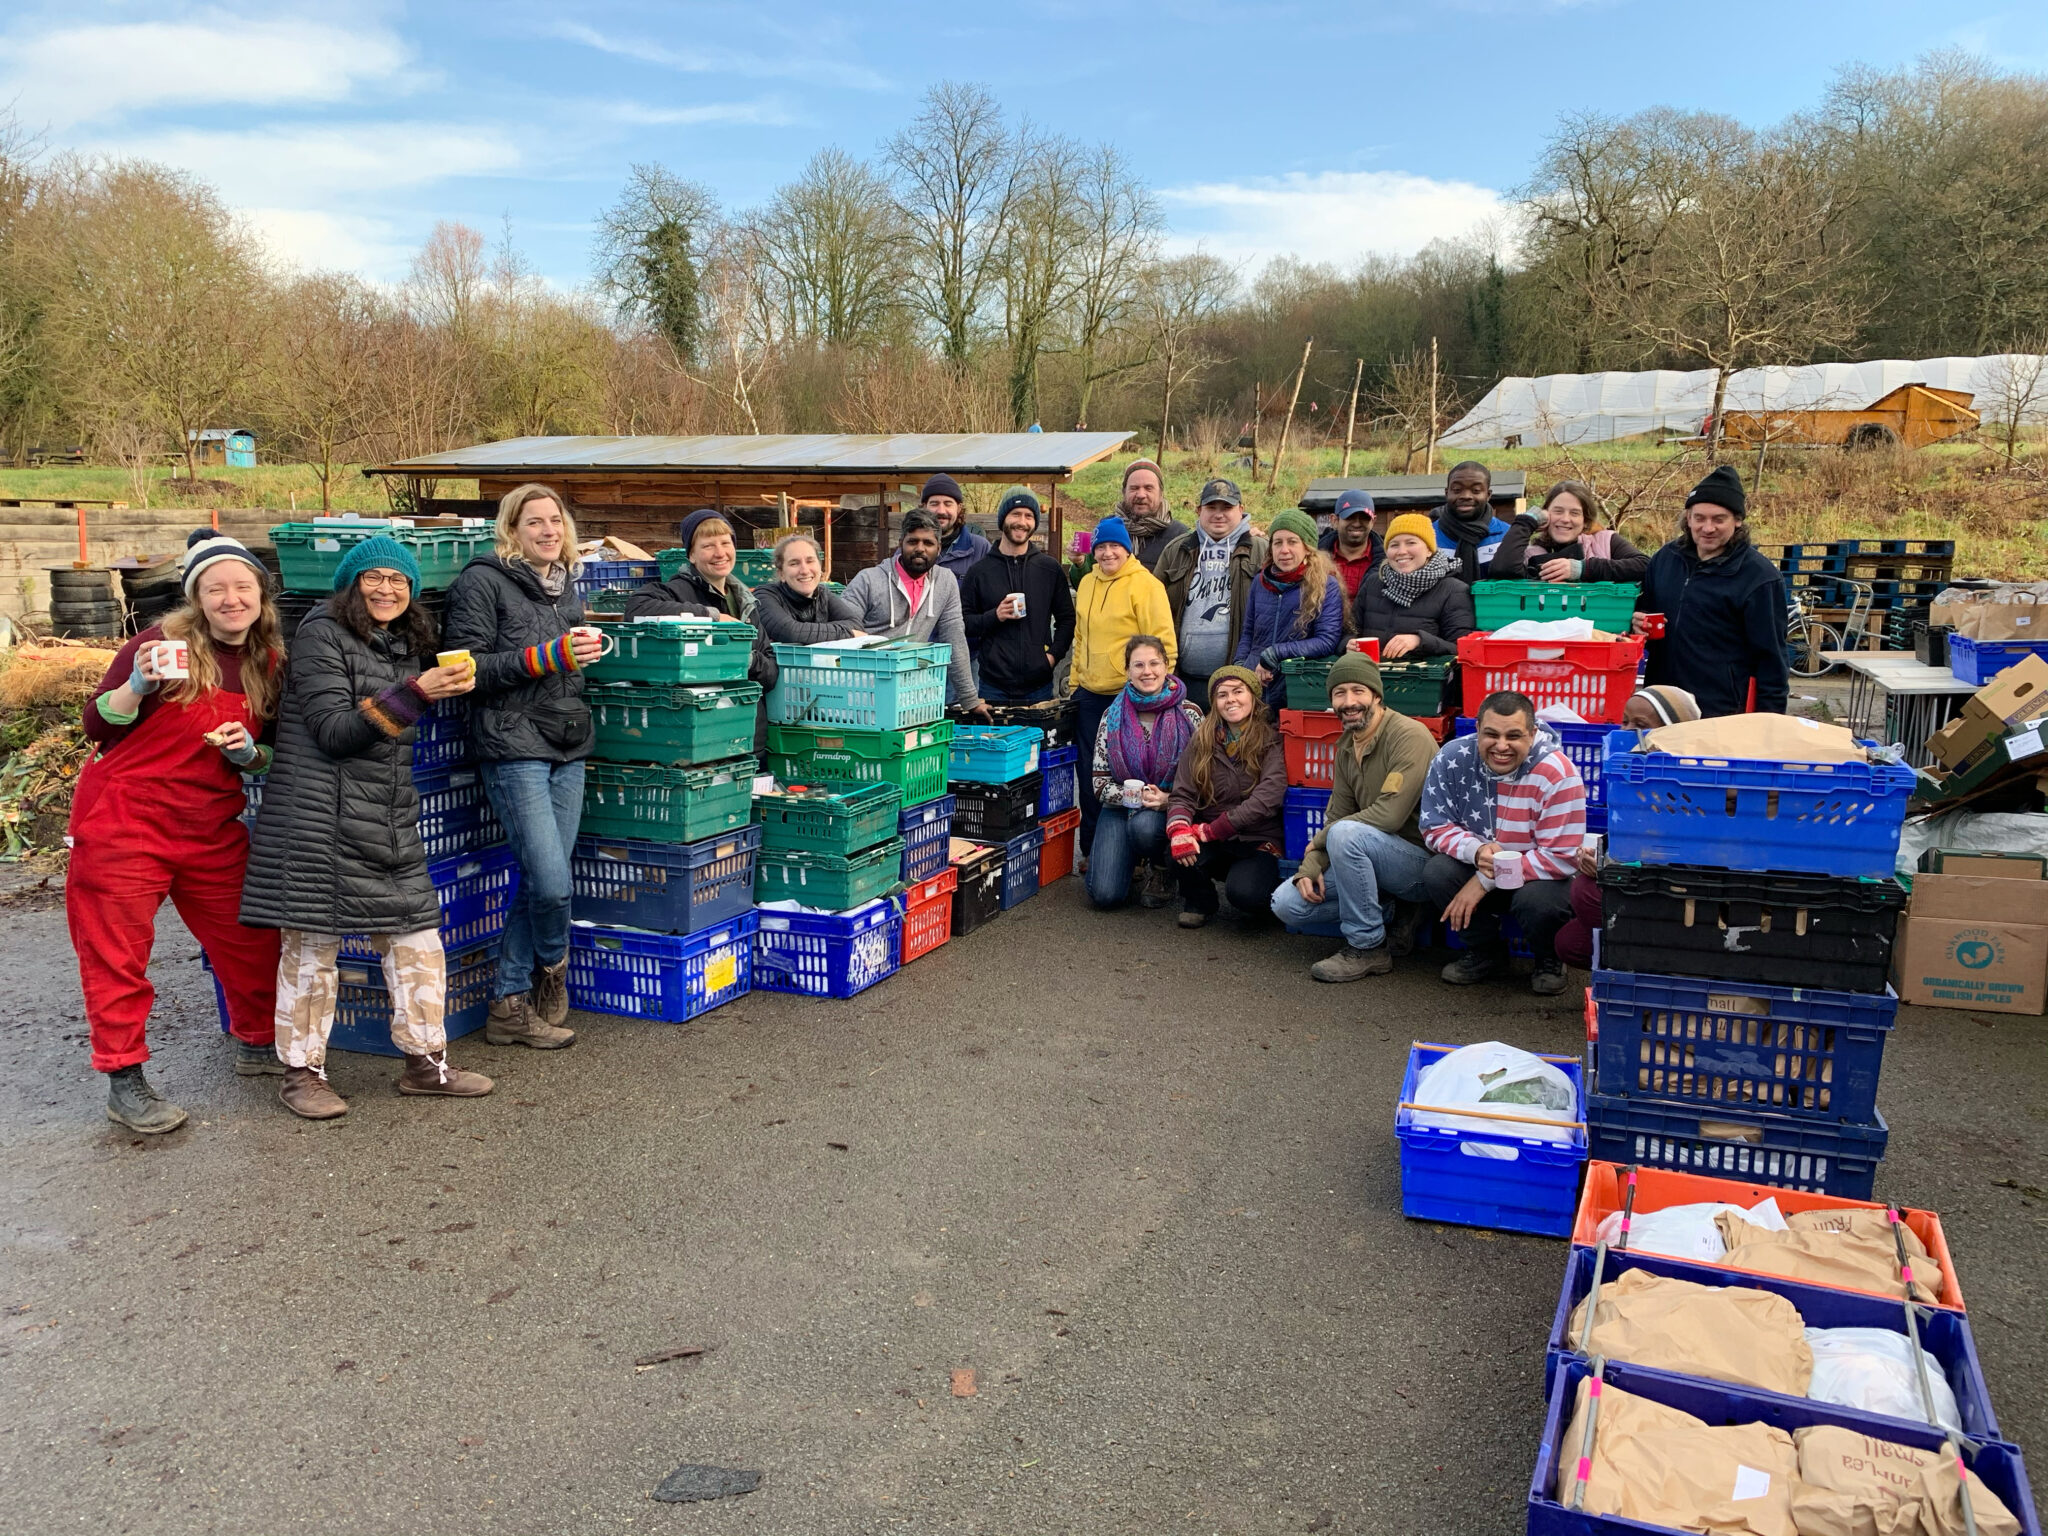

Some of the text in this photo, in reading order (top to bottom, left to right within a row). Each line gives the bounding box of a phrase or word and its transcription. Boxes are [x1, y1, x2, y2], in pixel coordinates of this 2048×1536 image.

[1205, 561, 1226, 572] 1976
[813, 751, 851, 763] farmdrop
[1922, 977, 2025, 993] ORGANICALLY GROWN
[1932, 988, 2013, 1004] ENGLISH APPLES
